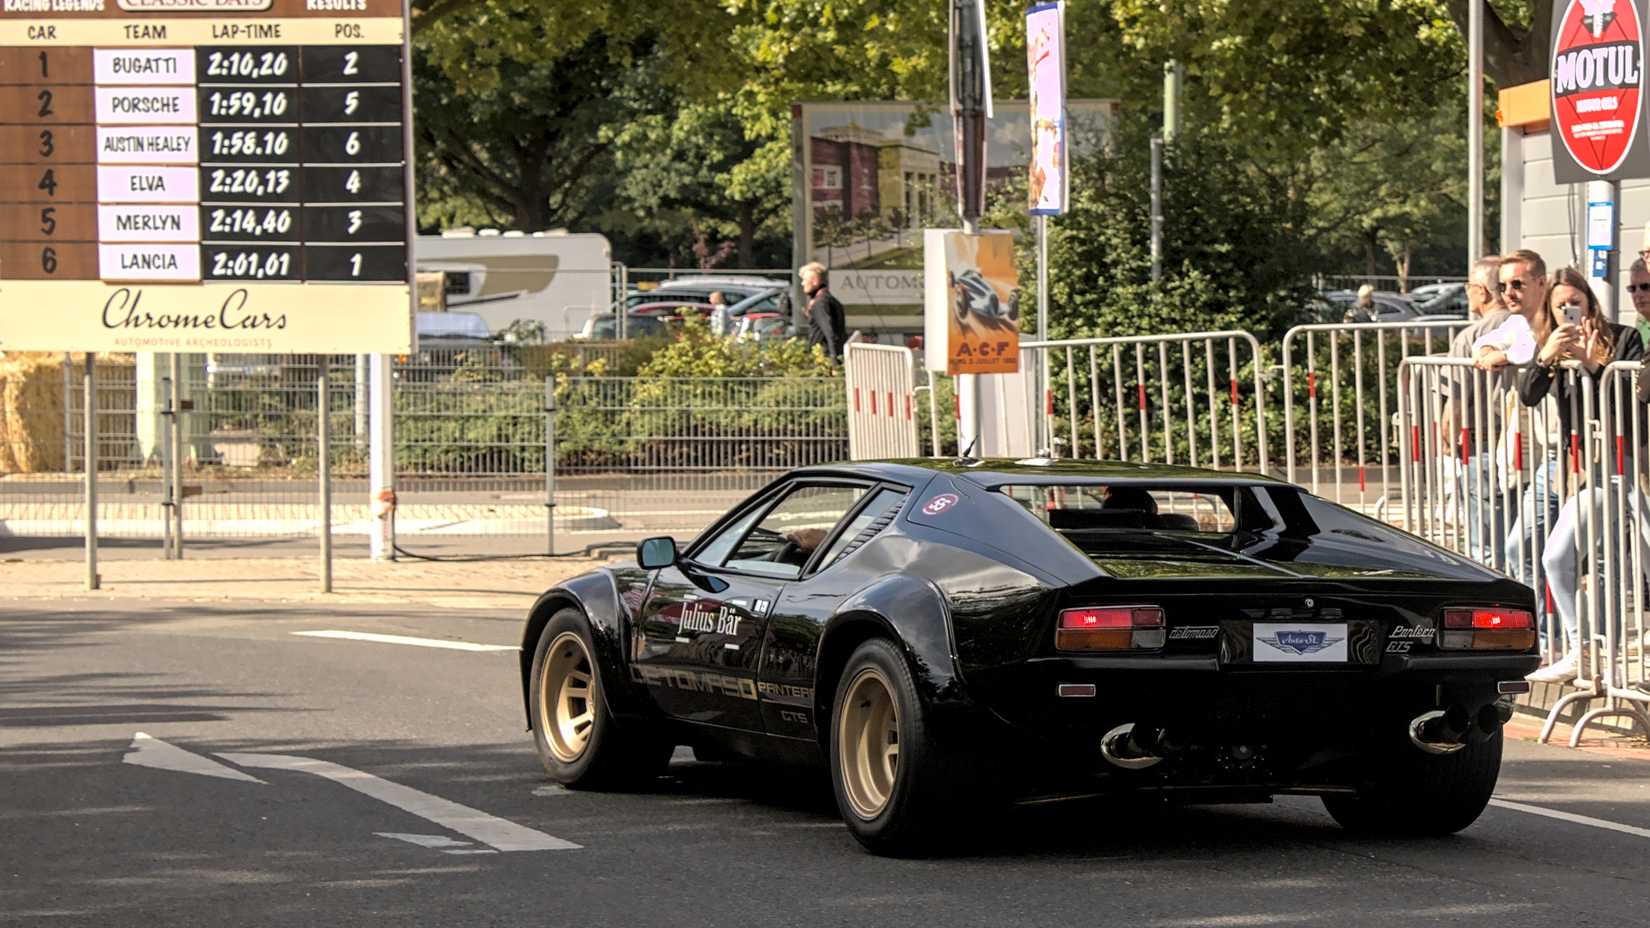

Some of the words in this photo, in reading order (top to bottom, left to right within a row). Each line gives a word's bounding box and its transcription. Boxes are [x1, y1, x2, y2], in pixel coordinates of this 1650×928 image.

[28, 25, 56, 40] CAR
[123, 25, 167, 40] TEAM
[212, 24, 281, 38] LAP-TIME
[335, 24, 365, 38] POS.
[38, 51, 48, 77] 1
[112, 57, 177, 73] BUGATTI
[343, 51, 358, 75] 2
[1556, 45, 1638, 93] MOTUL
[38, 90, 53, 117] 2
[112, 97, 180, 113] PORSCHE
[345, 91, 359, 114] 5
[39, 130, 54, 157] 3
[104, 136, 144, 152] AUSTIN
[146, 136, 191, 152] HEALEY
[345, 131, 360, 155] 6
[38, 169, 57, 196] 4
[130, 175, 165, 191] ELVA
[345, 170, 361, 193] 4
[40, 207, 56, 235] 5
[116, 214, 181, 231] MERLYN
[347, 210, 362, 234] 3
[41, 247, 57, 274] 6
[121, 253, 178, 270] LANCIA
[350, 253, 362, 276] 1
[102, 288, 286, 329] ChromeCars
[114, 337, 181, 348] AUTOMOTIVE
[185, 337, 272, 349] ARCHEOLOGISTS
[677, 601, 715, 635] Julius
[717, 605, 742, 636] Bär
